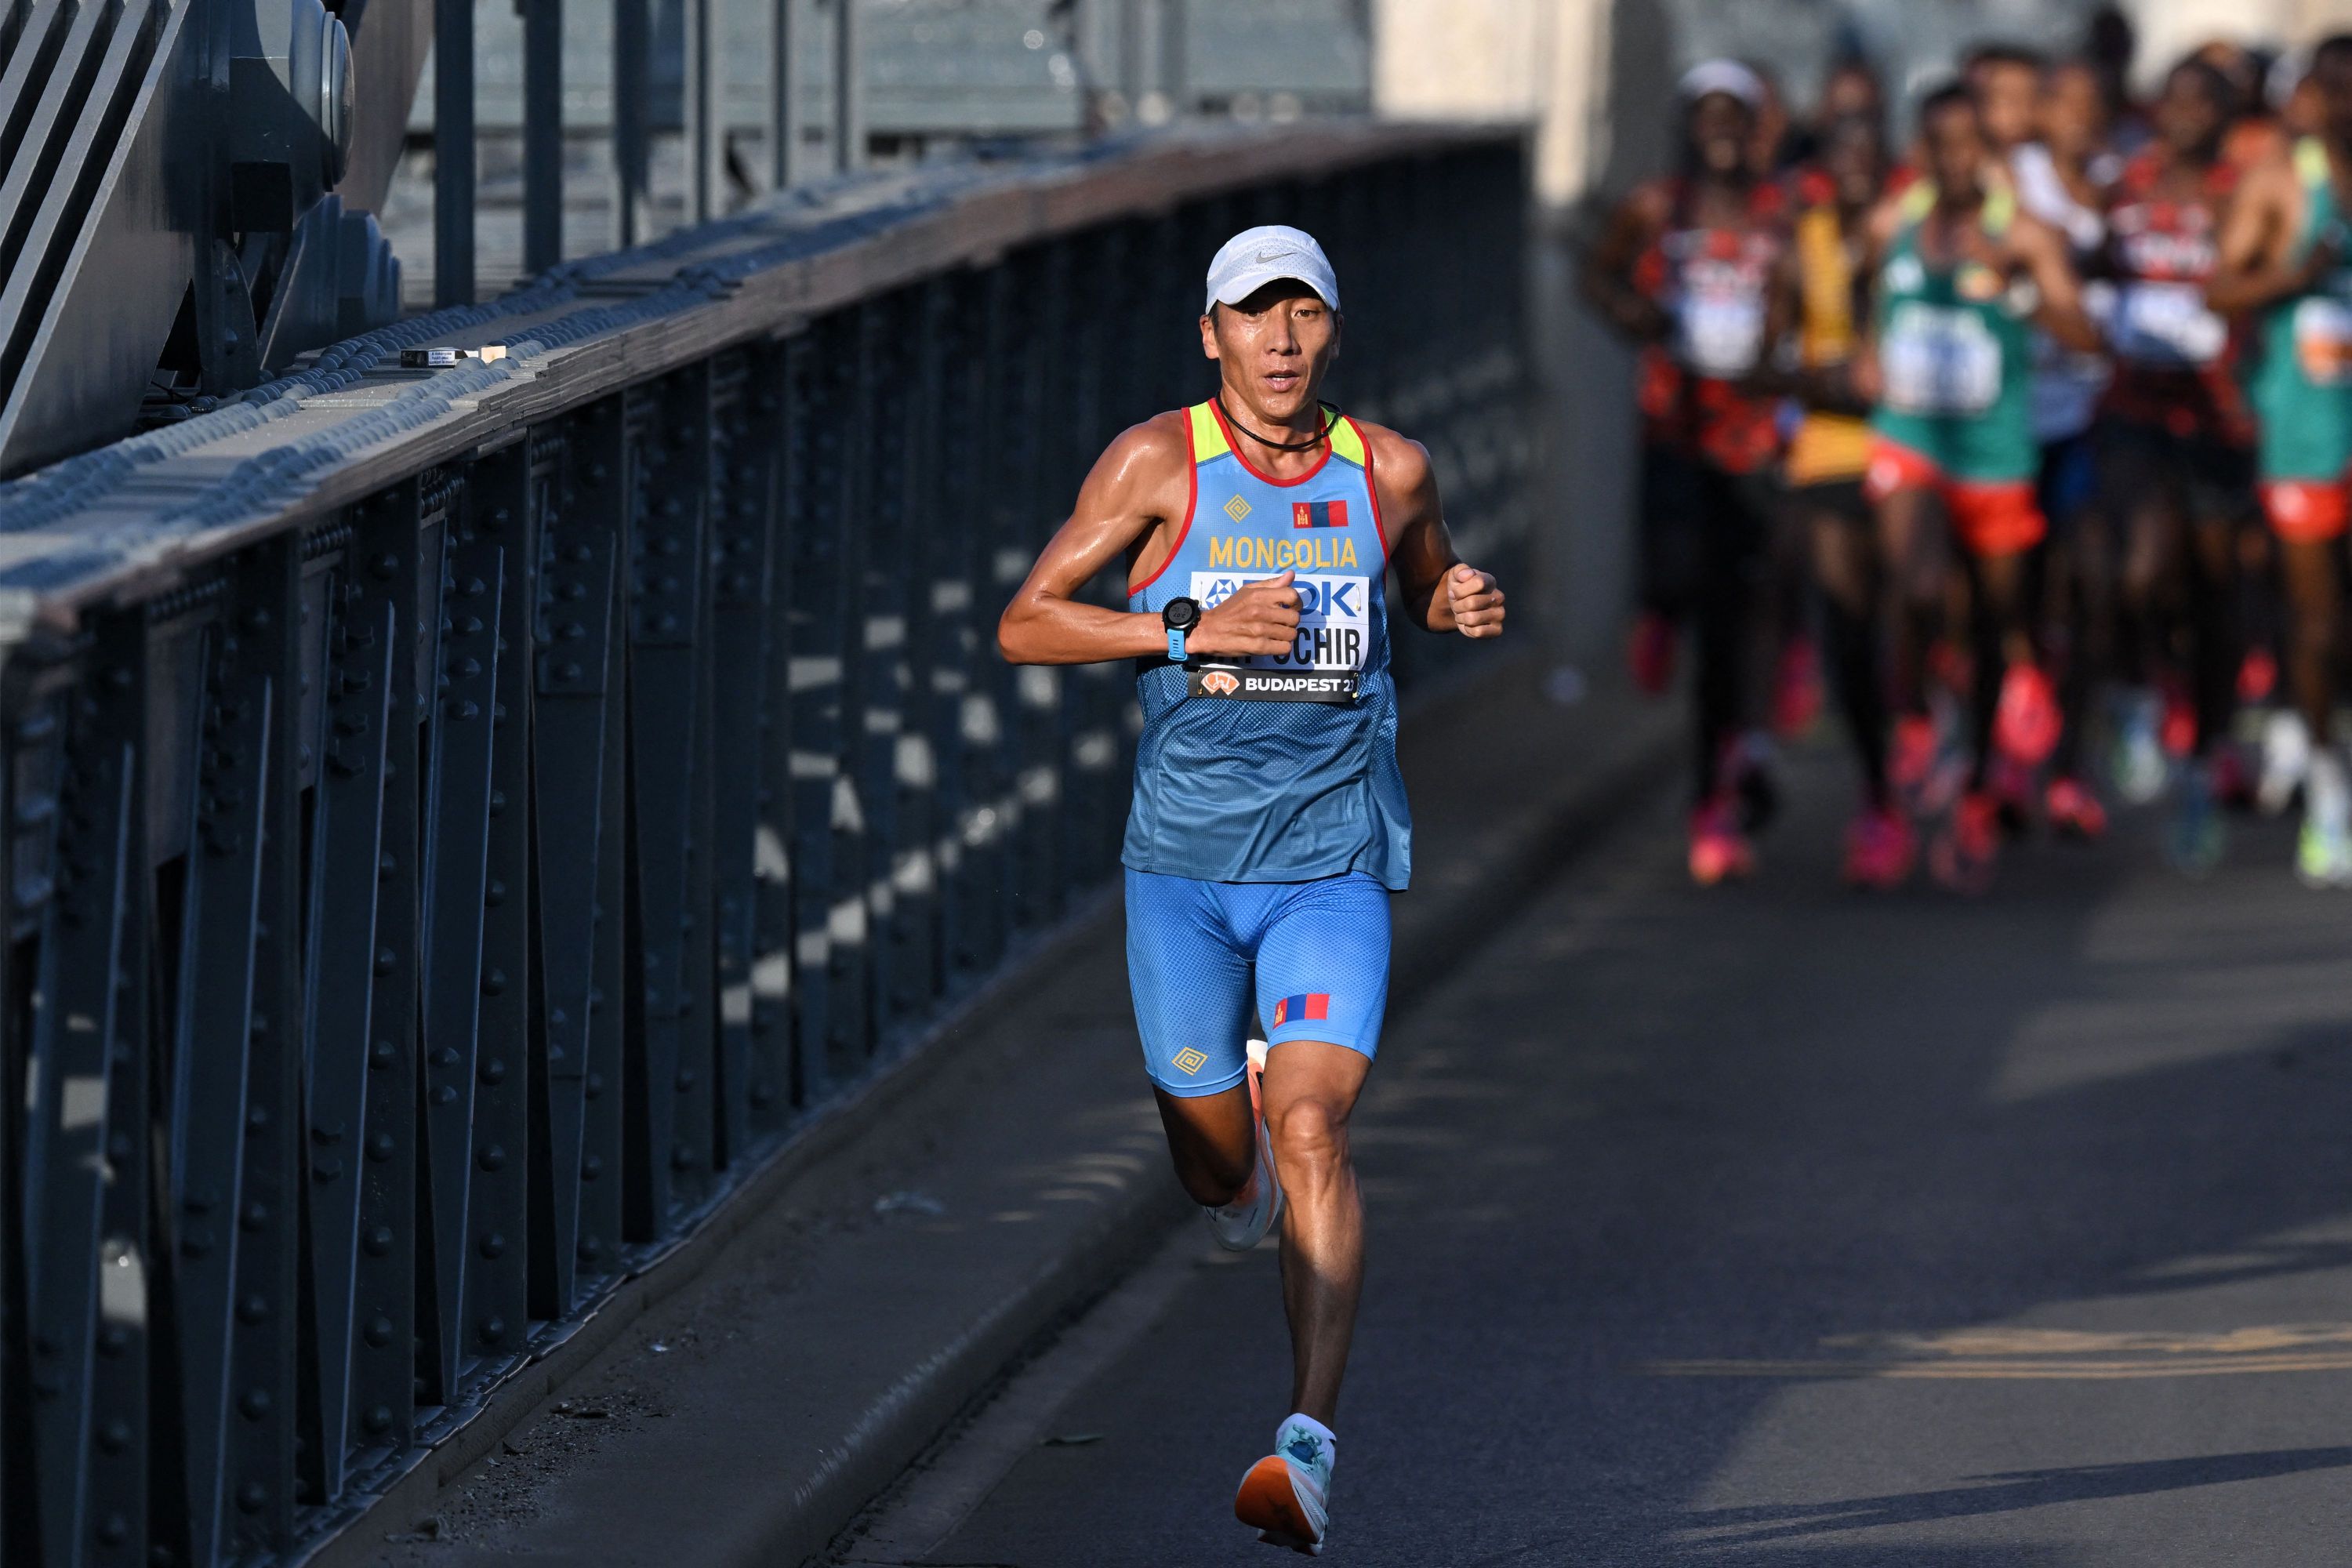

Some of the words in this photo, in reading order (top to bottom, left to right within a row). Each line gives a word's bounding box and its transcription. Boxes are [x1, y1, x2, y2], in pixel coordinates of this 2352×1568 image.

[1210, 536, 1358, 568] MONGOLIA
[1243, 579, 1359, 618] DK
[1272, 626, 1360, 666] CHIR
[1245, 677, 1341, 693] BUDAPEST
